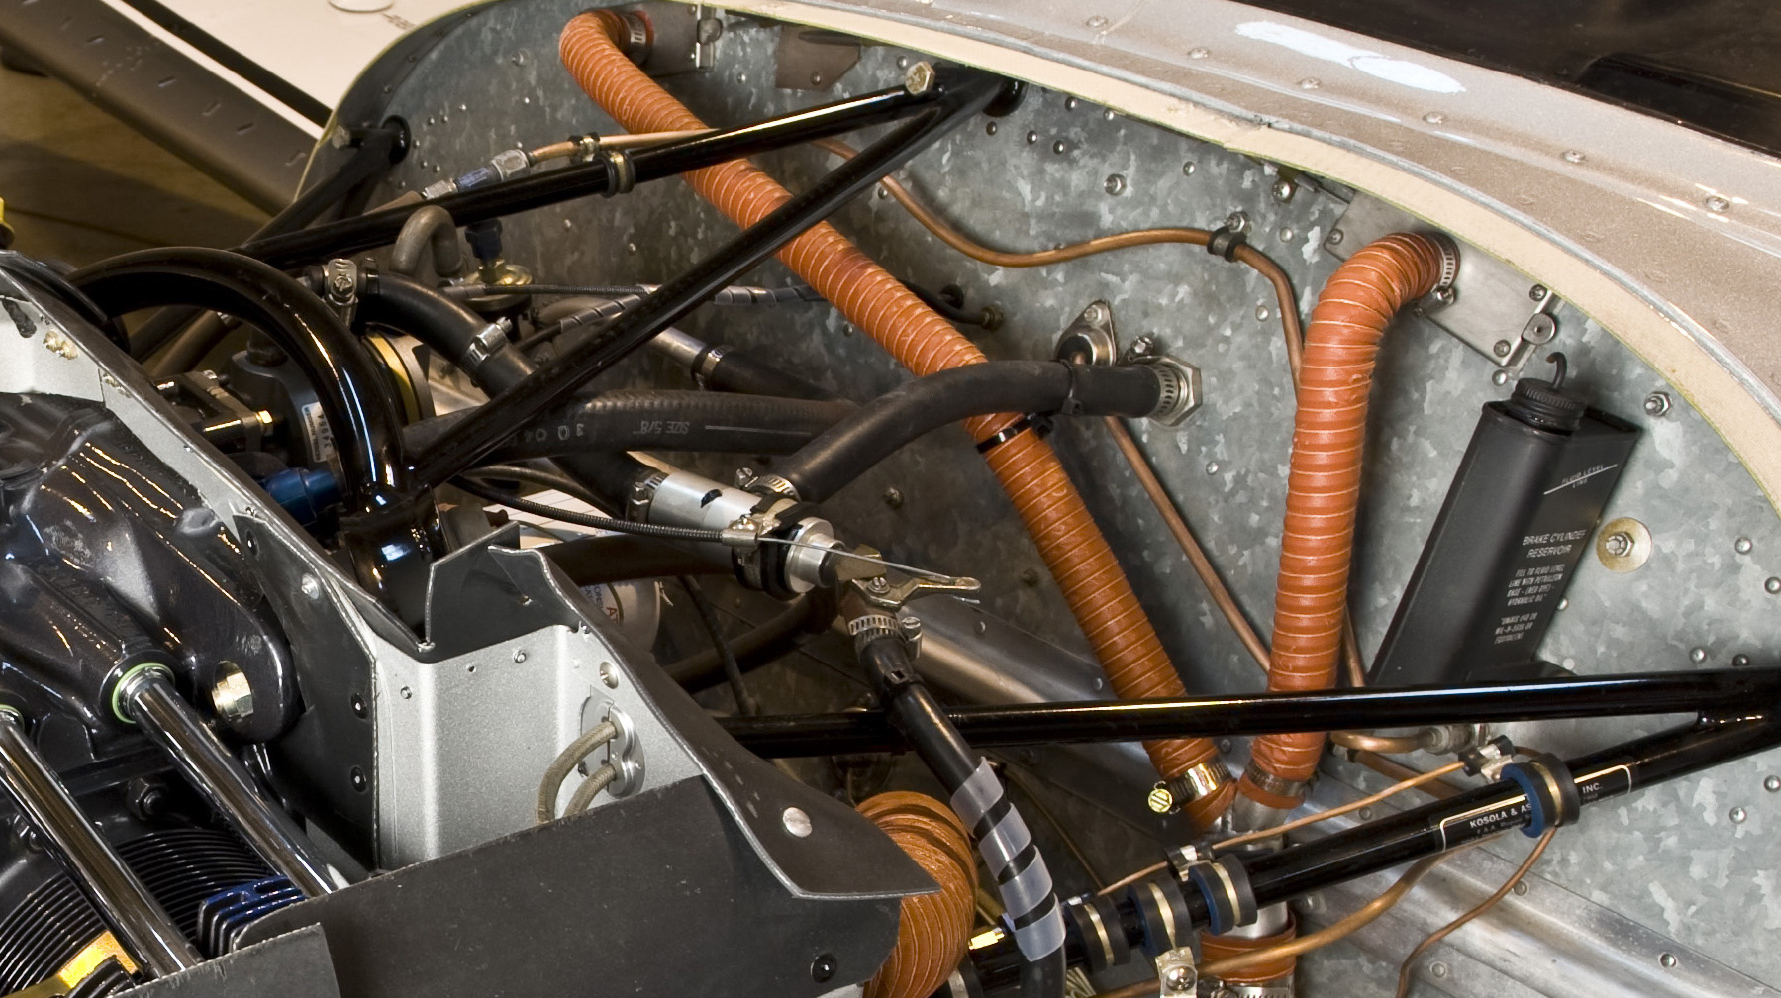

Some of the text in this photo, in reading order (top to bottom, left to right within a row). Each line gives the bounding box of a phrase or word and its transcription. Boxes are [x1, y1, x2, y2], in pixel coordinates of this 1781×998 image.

[666, 420, 691, 435] SIZE
[1523, 533, 1550, 546] BRAKE
[1526, 544, 1572, 559] RESERVOIR
[1470, 810, 1508, 829] KOSOLA
[1511, 807, 1518, 817] &
